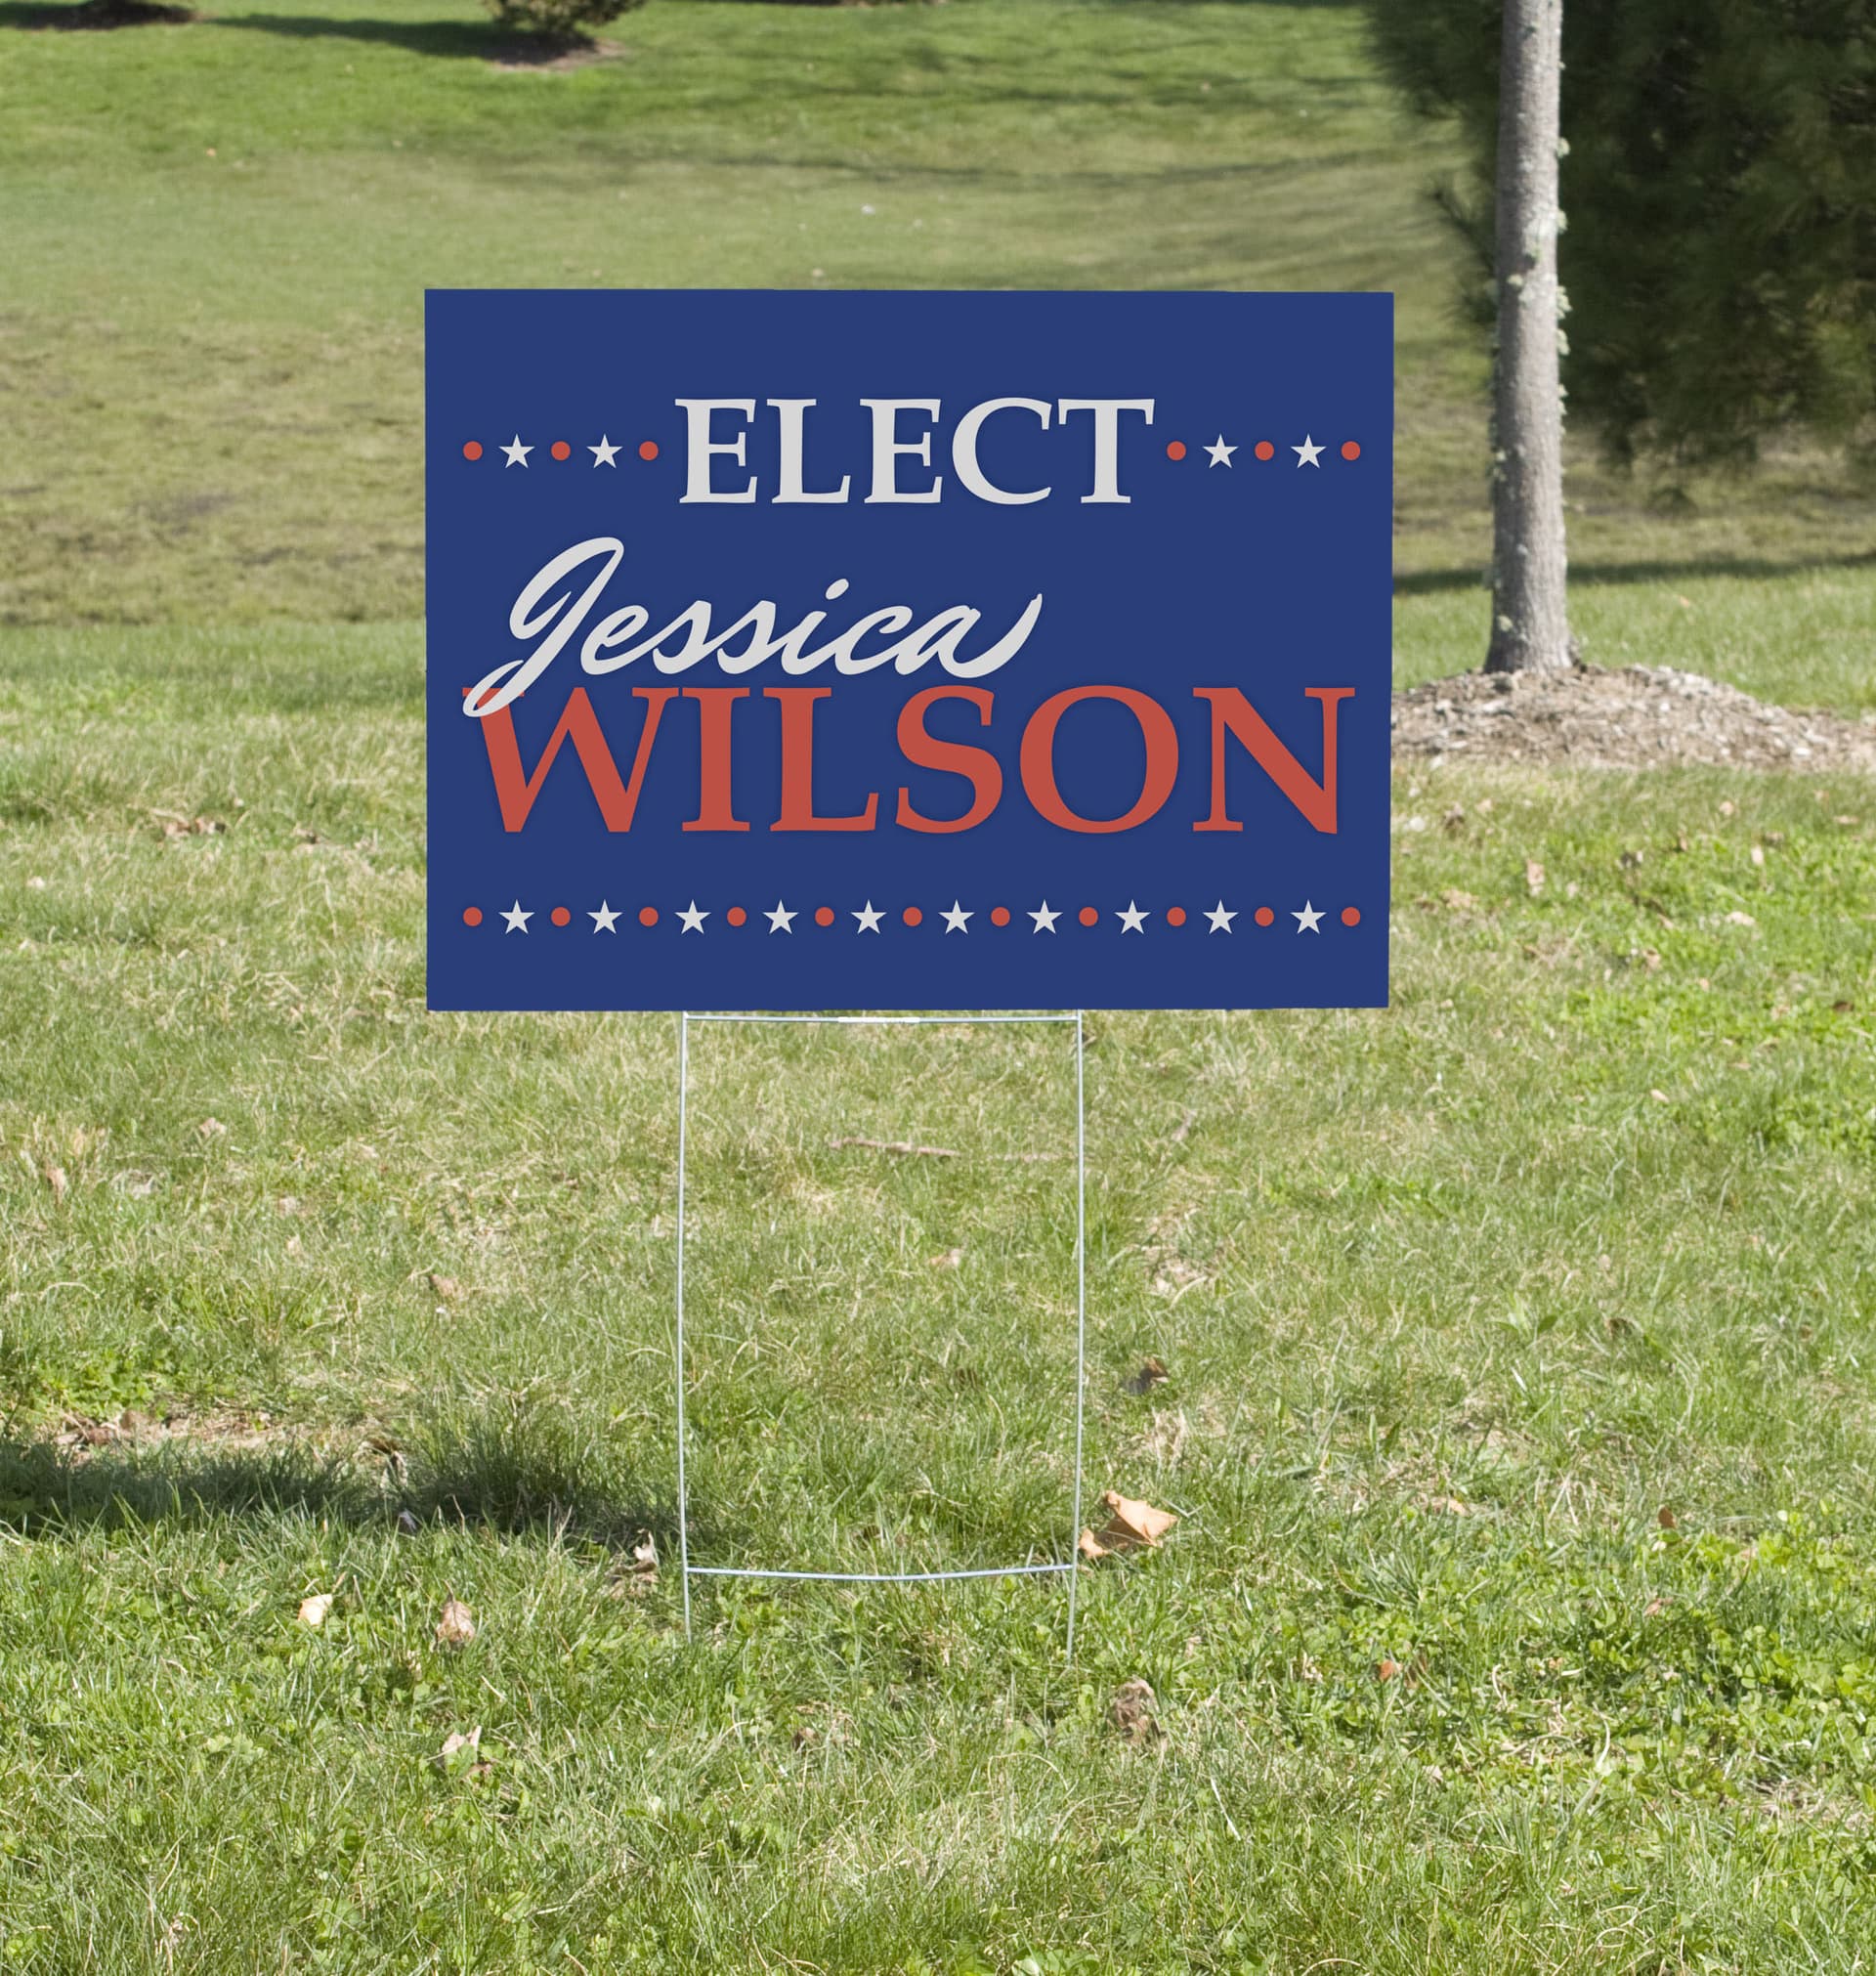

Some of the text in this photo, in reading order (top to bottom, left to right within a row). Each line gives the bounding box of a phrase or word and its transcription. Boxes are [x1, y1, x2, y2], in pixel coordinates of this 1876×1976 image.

[675, 398, 1154, 504] ELECT
[463, 537, 1042, 717] Jessica
[463, 686, 1355, 834] WILSON
